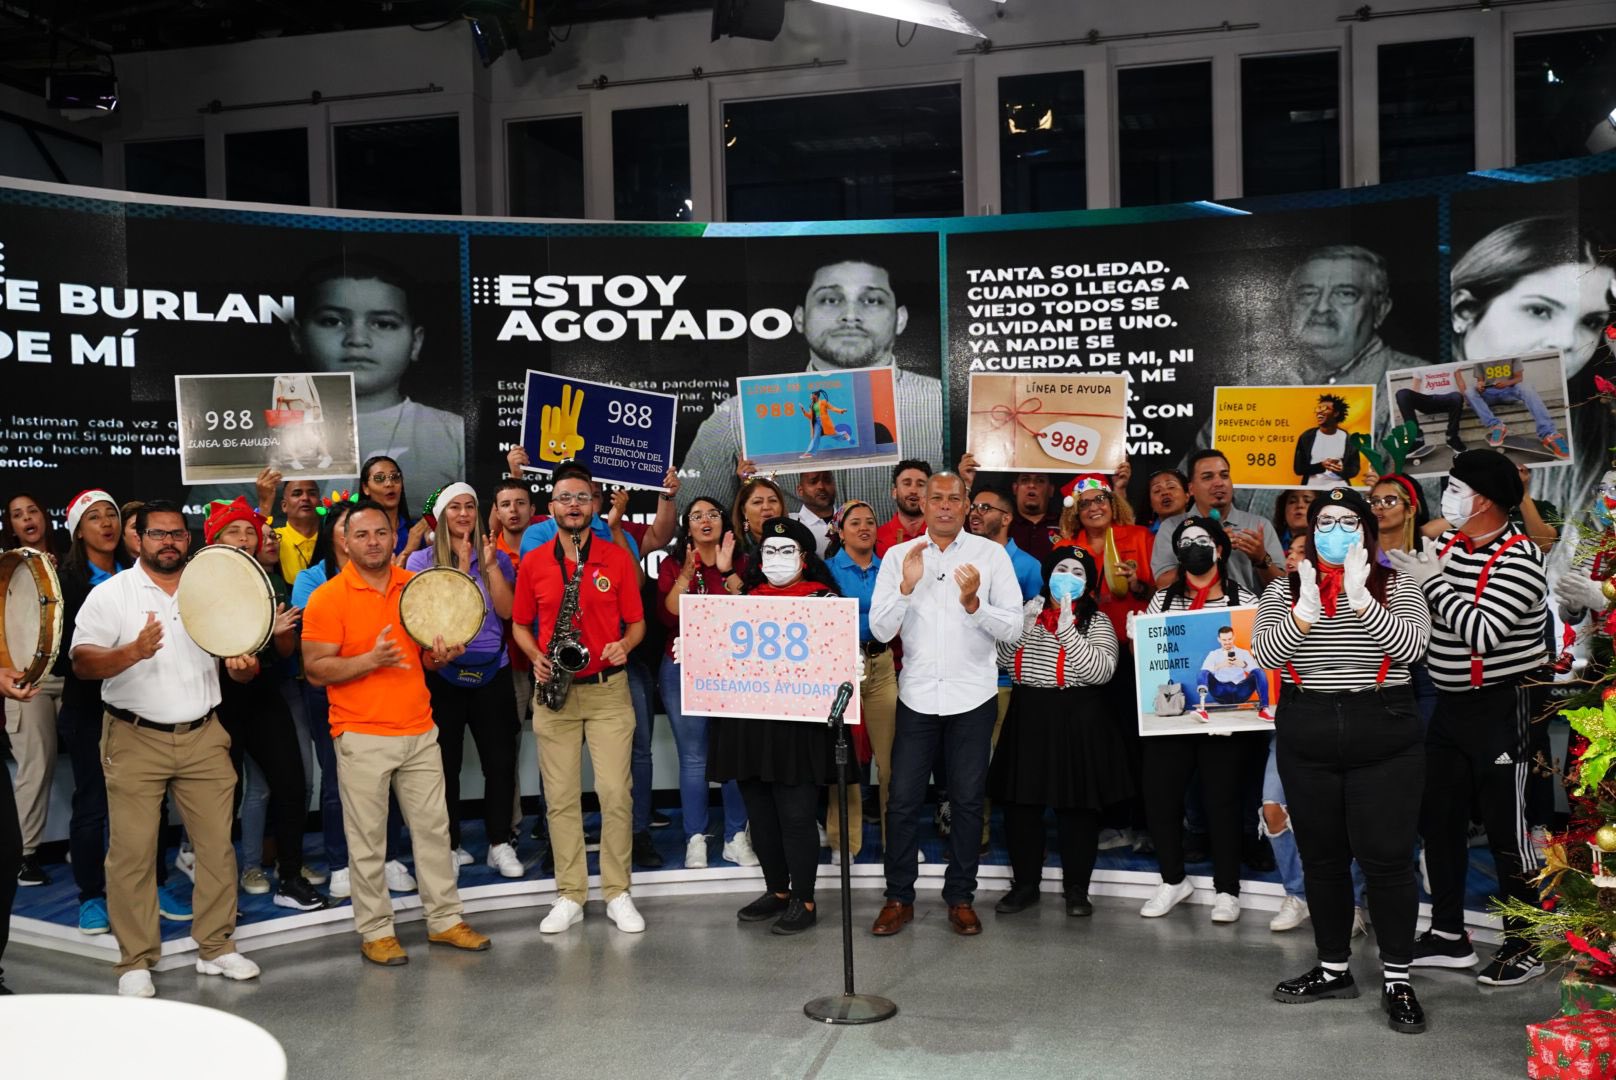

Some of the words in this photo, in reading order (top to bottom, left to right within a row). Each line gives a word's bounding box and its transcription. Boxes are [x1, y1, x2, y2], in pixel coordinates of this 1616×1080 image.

[967, 267, 1045, 282] TANTA
[1051, 260, 1170, 279] SOLEDAD.
[499, 274, 687, 307] ESTOY
[967, 282, 1069, 300] CUANDO
[1075, 278, 1165, 296] LLEGAS
[1171, 276, 1190, 291] A
[0, 279, 41, 312] E
[59, 283, 296, 324] BURLAN
[968, 301, 1036, 318] VIEJO
[1041, 298, 1125, 315] TODOS
[1131, 297, 1160, 311] SE
[497, 308, 793, 342] AGOTADO
[968, 318, 1073, 336] OLVIDAN
[1080, 317, 1113, 332] DE
[1119, 314, 1178, 330] UNO.
[71, 328, 139, 367] MÍ
[969, 340, 1002, 354] YA
[1006, 337, 1079, 353] NADIE
[1086, 335, 1115, 349] SE
[969, 355, 1083, 371] ACUERDA
[1090, 352, 1122, 366] DE
[1128, 350, 1163, 367] MI,
[1170, 349, 1194, 363] NI
[1141, 368, 1176, 383] ME
[1485, 364, 1512, 379] 988
[629, 380, 657, 389] esta
[662, 379, 730, 391] pandemia
[1026, 381, 1056, 394] LÍNEA
[1060, 384, 1073, 394] DE
[1076, 385, 1112, 395] AYUDA
[1426, 378, 1451, 390] Ayuda
[711, 391, 732, 401] No
[607, 400, 653, 429] 988
[682, 405, 704, 413] me
[756, 402, 796, 419] 988
[1142, 403, 1194, 419] CON
[1218, 402, 1244, 412] LÍNEA
[1246, 403, 1257, 412] DE
[12, 415, 79, 427] lastiman
[88, 418, 124, 429] cada
[132, 420, 158, 429] vez
[205, 409, 254, 431] 988
[1218, 418, 1272, 427] PREVENCIÓN
[1275, 419, 1290, 428] DEL
[33, 430, 52, 440] de
[83, 430, 96, 441] Si
[100, 431, 165, 442] supieran
[222, 438, 238, 448] DE
[240, 437, 281, 448] AYUDA
[611, 434, 636, 448] LÍNEA
[637, 440, 649, 449] DE
[1050, 431, 1089, 456] 988
[1217, 434, 1256, 442] SUICIDIO
[1266, 434, 1295, 443] CRISIS
[18, 445, 44, 454] me
[53, 445, 103, 455] hacen.
[110, 445, 131, 455] No
[594, 444, 646, 460] PREVENCIÓN
[647, 452, 664, 463] DEL
[593, 455, 630, 469] SUICIDIO
[630, 461, 638, 470] Y
[638, 462, 664, 474] CRISIS
[1246, 453, 1277, 467] 988
[1148, 624, 1186, 638] ESTAMOS
[729, 620, 810, 662] 988
[1157, 642, 1180, 654] PARA
[1149, 657, 1190, 672] AYUDARTE
[695, 678, 771, 694] DESEAMOS
[774, 681, 839, 697] AYUDART
